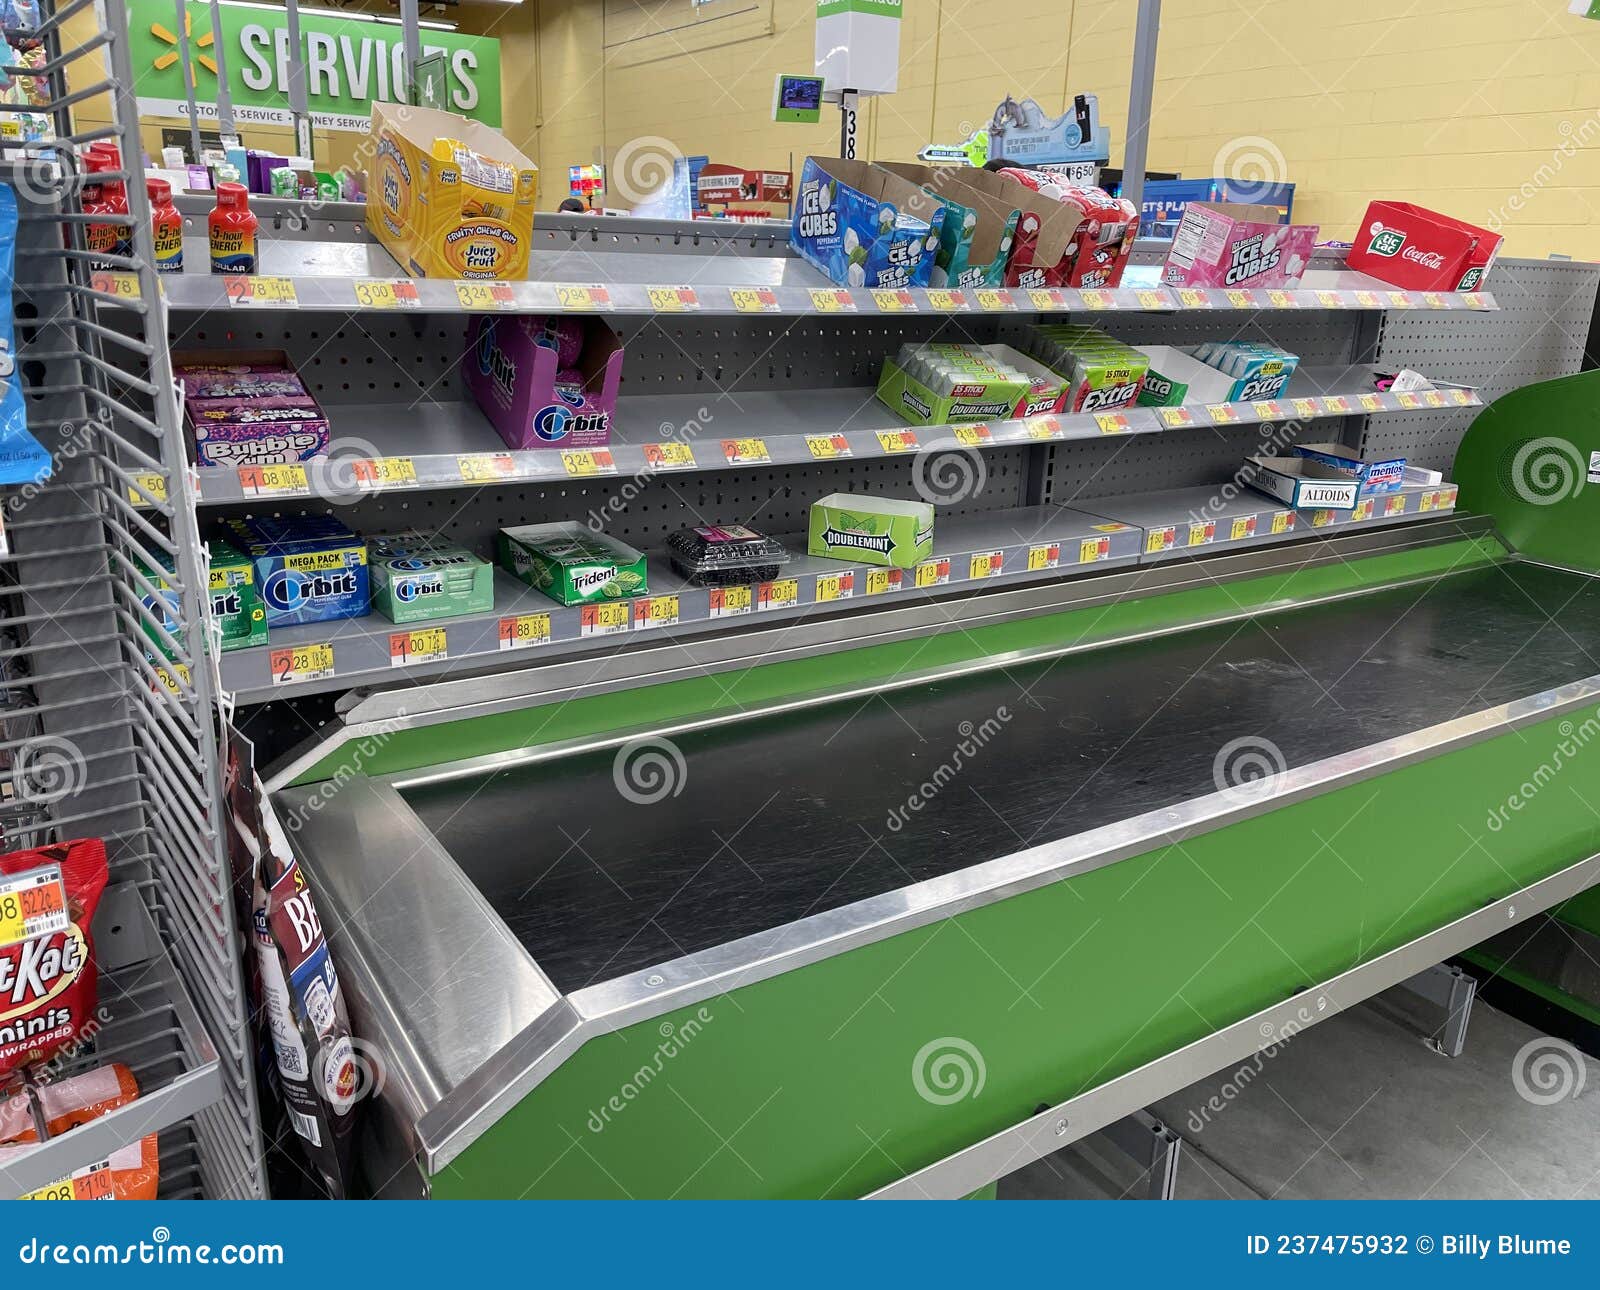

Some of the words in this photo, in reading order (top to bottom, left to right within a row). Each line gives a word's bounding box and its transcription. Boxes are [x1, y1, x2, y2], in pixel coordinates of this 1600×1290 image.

[240, 24, 479, 110] SERVICS
[241, 110, 283, 122] SERVICE
[309, 117, 334, 126] ONEY
[337, 119, 371, 129] SERVIC
[802, 190, 819, 214] ICE
[1142, 202, 1163, 213] ET'S
[1165, 201, 1186, 212] PLA
[158, 224, 182, 240] 5-ho
[212, 224, 243, 241] 5-hour
[800, 212, 837, 238] CUBES
[447, 227, 475, 243] FRUITY
[476, 226, 502, 238] CHEWS
[501, 231, 518, 244] GUM
[1384, 234, 1399, 246] tic
[210, 240, 243, 252] ENERGY
[465, 245, 497, 258] Juicy
[1231, 243, 1262, 267] ICE
[1375, 241, 1396, 254] tac
[466, 255, 496, 268] Fruit
[1225, 250, 1282, 286] CUBES
[462, 270, 497, 279] ORIGINAL
[1142, 377, 1171, 395] xtra
[1239, 376, 1285, 401] Extra
[1081, 382, 1138, 413] Extra
[950, 404, 1005, 415] DOUBLEMINT
[1024, 399, 1056, 417] Extra
[533, 405, 609, 441] Orbit
[206, 434, 316, 459] Bubble
[1369, 465, 1402, 477] mentos
[1304, 489, 1350, 501] ALTOIDS
[828, 531, 890, 551] DOUBLEMINT
[289, 556, 316, 567] MEGA
[318, 554, 341, 564] PACK
[571, 565, 617, 591] Trident
[264, 568, 358, 612] Orbit
[395, 580, 443, 603] Orbit
[0, 936, 80, 1003] tKat
[0, 1027, 73, 1060] NWRAPPED
